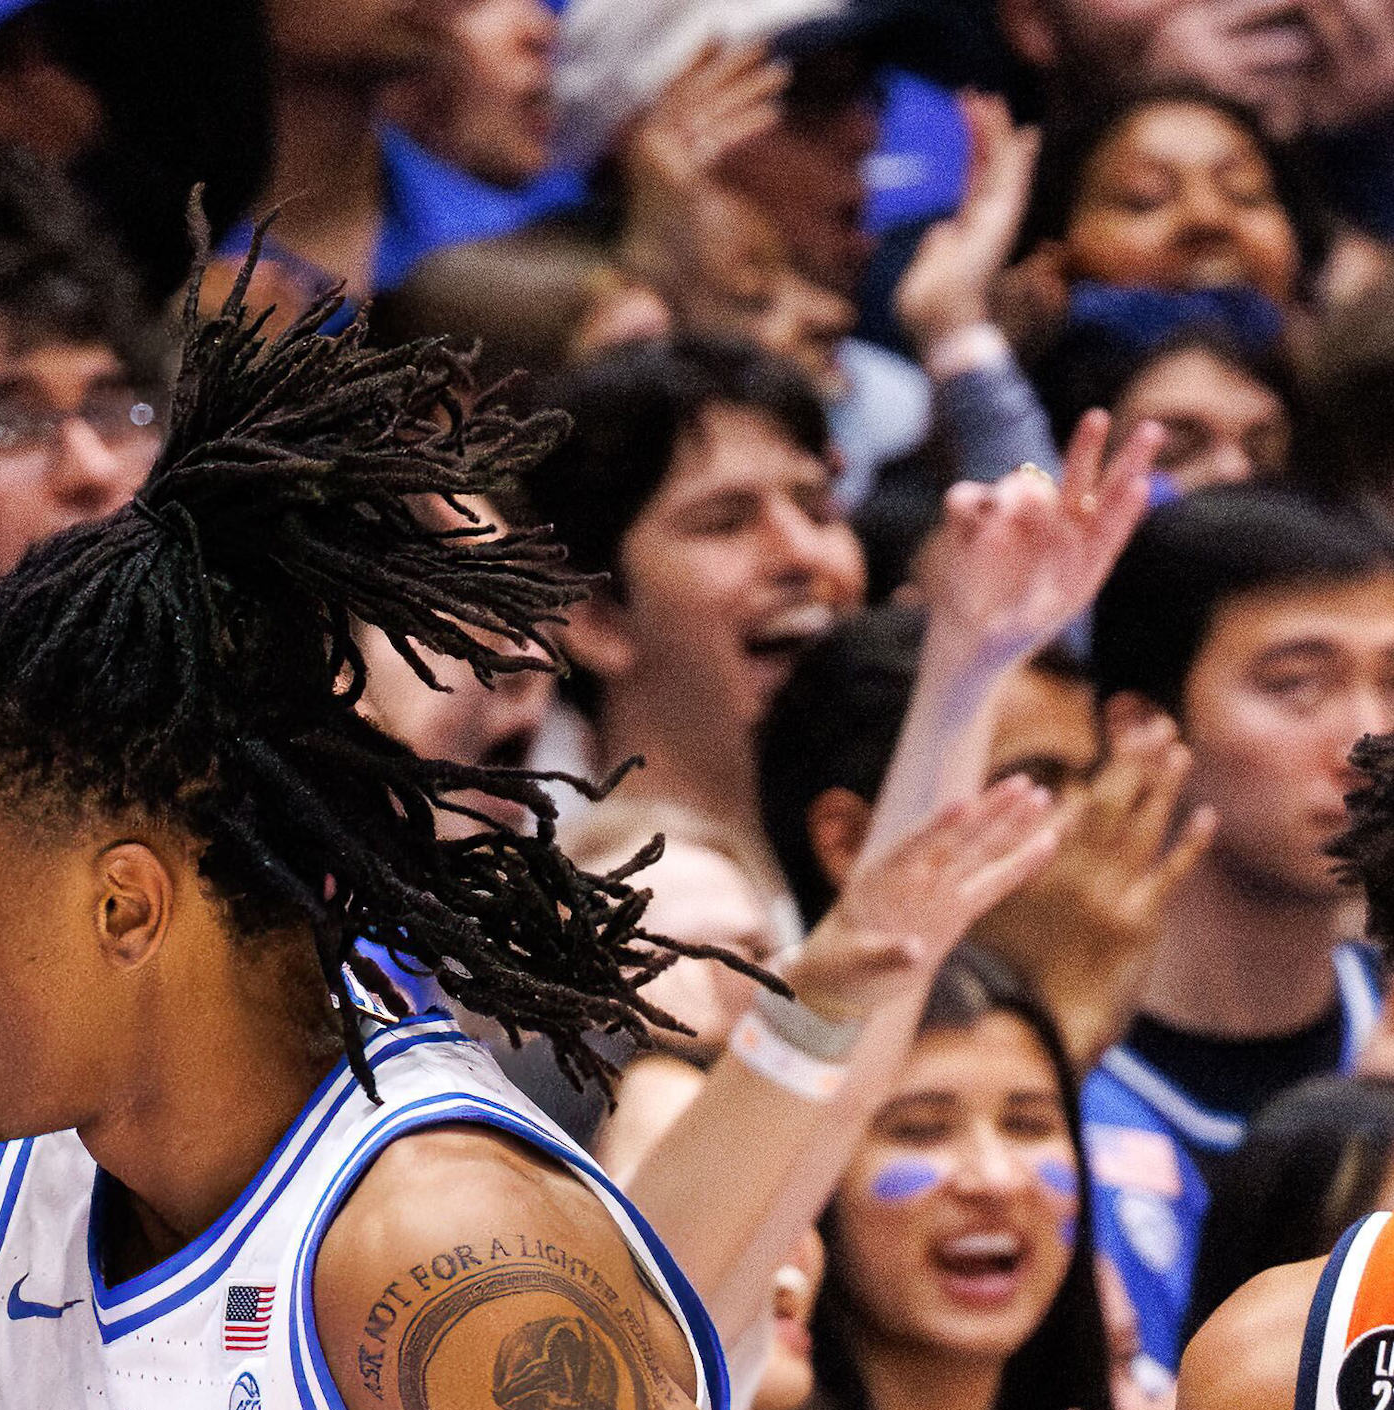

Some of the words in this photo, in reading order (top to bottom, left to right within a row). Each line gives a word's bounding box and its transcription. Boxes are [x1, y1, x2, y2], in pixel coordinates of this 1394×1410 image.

[364, 1281, 412, 1344] NOT
[409, 1244, 484, 1292] FOR
[490, 1237, 514, 1260] A
